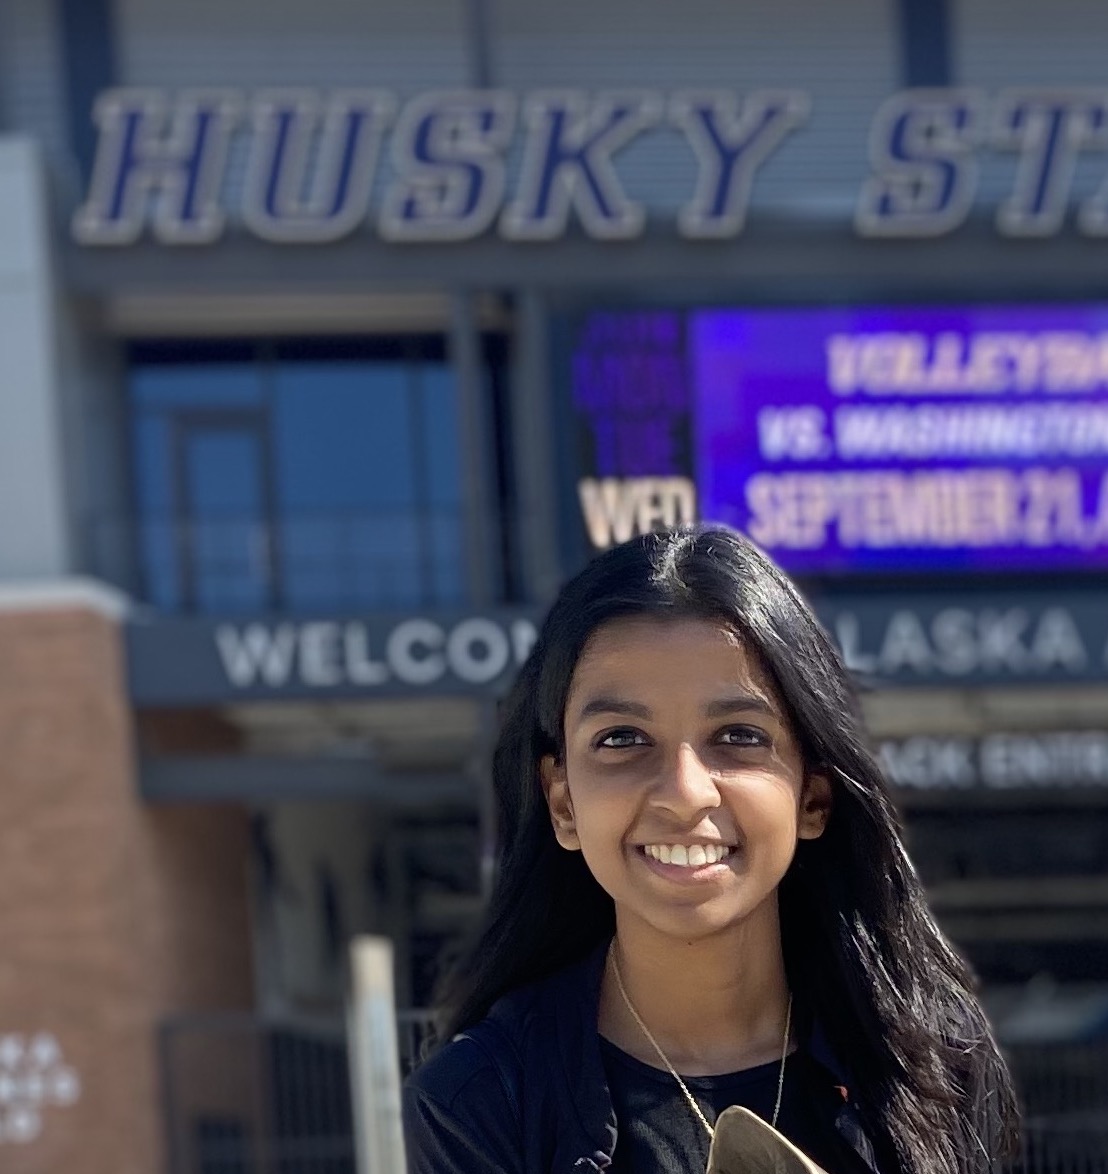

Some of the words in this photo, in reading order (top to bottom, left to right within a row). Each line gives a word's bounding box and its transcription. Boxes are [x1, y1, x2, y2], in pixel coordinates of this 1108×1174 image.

[72, 88, 812, 245] HUSKY
[215, 617, 538, 688] WELCO
[836, 608, 1089, 676] LASKA
